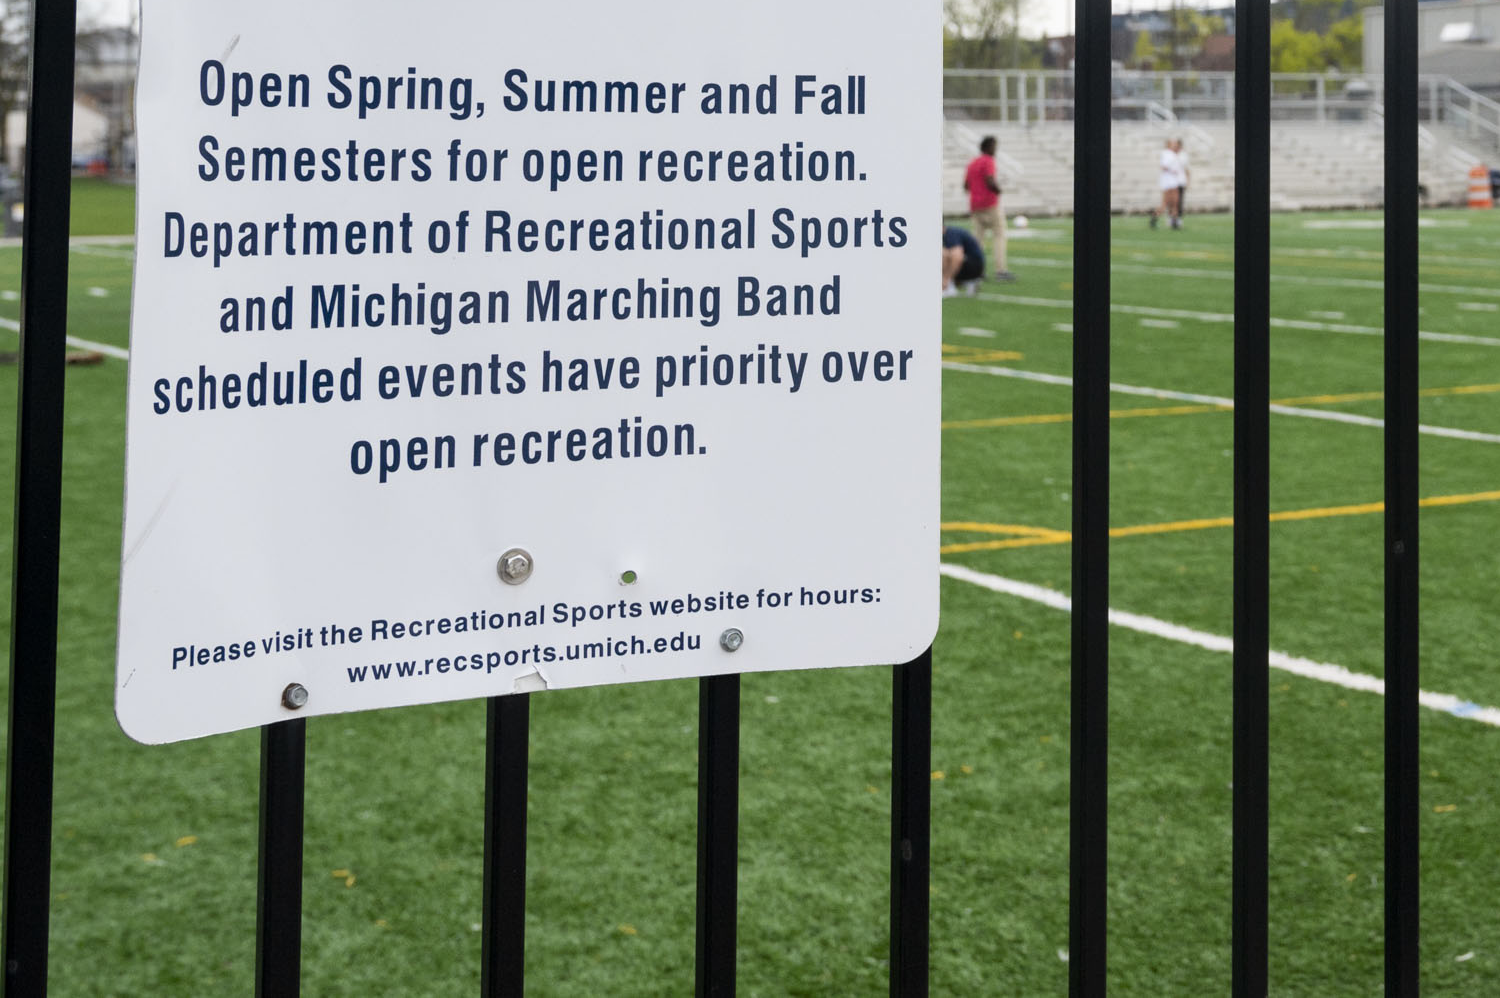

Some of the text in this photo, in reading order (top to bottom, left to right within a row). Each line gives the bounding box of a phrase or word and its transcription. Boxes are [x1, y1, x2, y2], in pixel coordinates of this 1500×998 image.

[200, 60, 866, 120] Open Spring, Summer and Fall
[198, 135, 867, 192] Semesters for open recreation.
[165, 208, 908, 268] Department of Recreational Sports
[220, 275, 841, 335] and Michigan Marching Band
[153, 343, 913, 415] scheduled events have priority over
[350, 416, 707, 484] open recreation.
[172, 586, 882, 670] Please visit the Recreational Sports website for hours:
[346, 631, 702, 684] www.recsports.umich.edu
